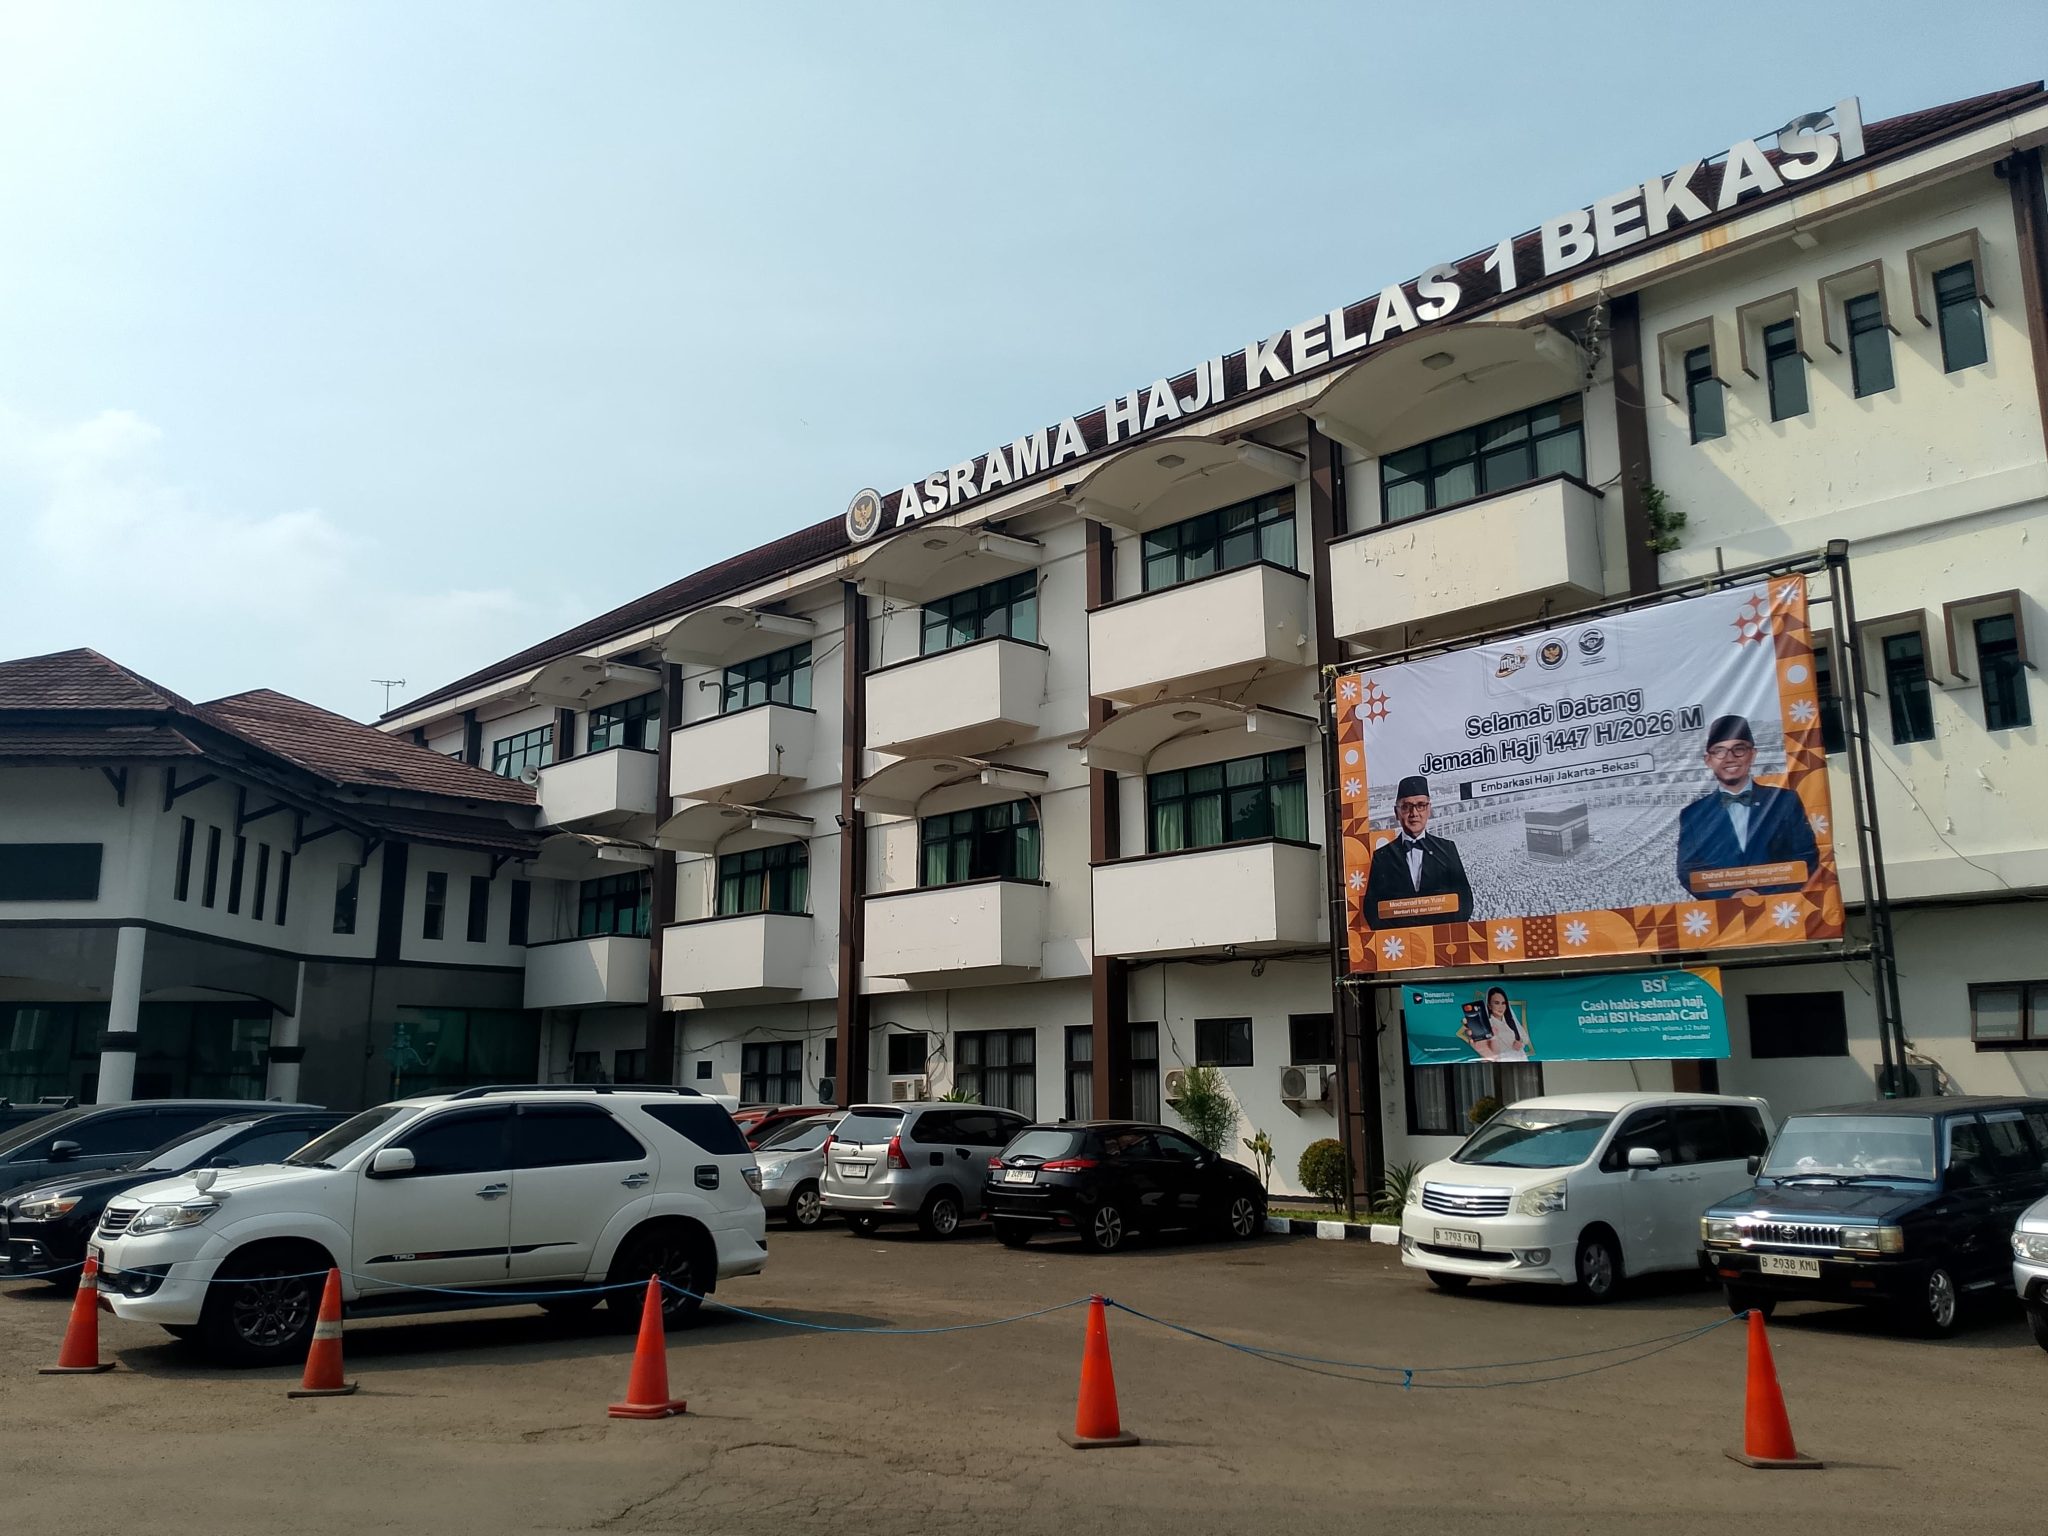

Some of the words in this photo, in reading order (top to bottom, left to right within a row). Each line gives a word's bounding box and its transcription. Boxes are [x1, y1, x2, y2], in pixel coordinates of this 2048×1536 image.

[895, 416, 1089, 527] ASRAMA
[1105, 355, 1225, 445] HAJI
[1245, 262, 1461, 390] KELAS
[1484, 238, 1518, 293] 1
[1541, 96, 1867, 277] BEKASI
[1466, 704, 1552, 738] Selamat
[1558, 690, 1642, 721] Datang
[1420, 745, 1496, 774] Jemaah
[1501, 736, 1540, 762] Haji
[1545, 727, 1589, 753] 1447
[1596, 712, 1674, 745] H/2026
[1680, 706, 1703, 730] M
[1480, 777, 1533, 793] Embarkasi
[1534, 773, 1555, 786] Haji
[1641, 979, 1668, 993] BSI
[1581, 1000, 1609, 1011] Cash
[1609, 998, 1640, 1010] habis
[1640, 996, 1681, 1009] selama
[1682, 995, 1707, 1009] haji,
[1577, 1012, 1608, 1026] pakai
[1609, 1012, 1628, 1023] BSI
[1629, 1009, 1680, 1022] Hasanah
[1680, 1008, 1709, 1020] Card
[1435, 1230, 1440, 1239] B
[1444, 1231, 1462, 1242] 1793
[392, 1253, 416, 1261] TRD
[1761, 1256, 1768, 1267] B
[1773, 1257, 1796, 1269] 2938
[1799, 1259, 1817, 1271] KMU
